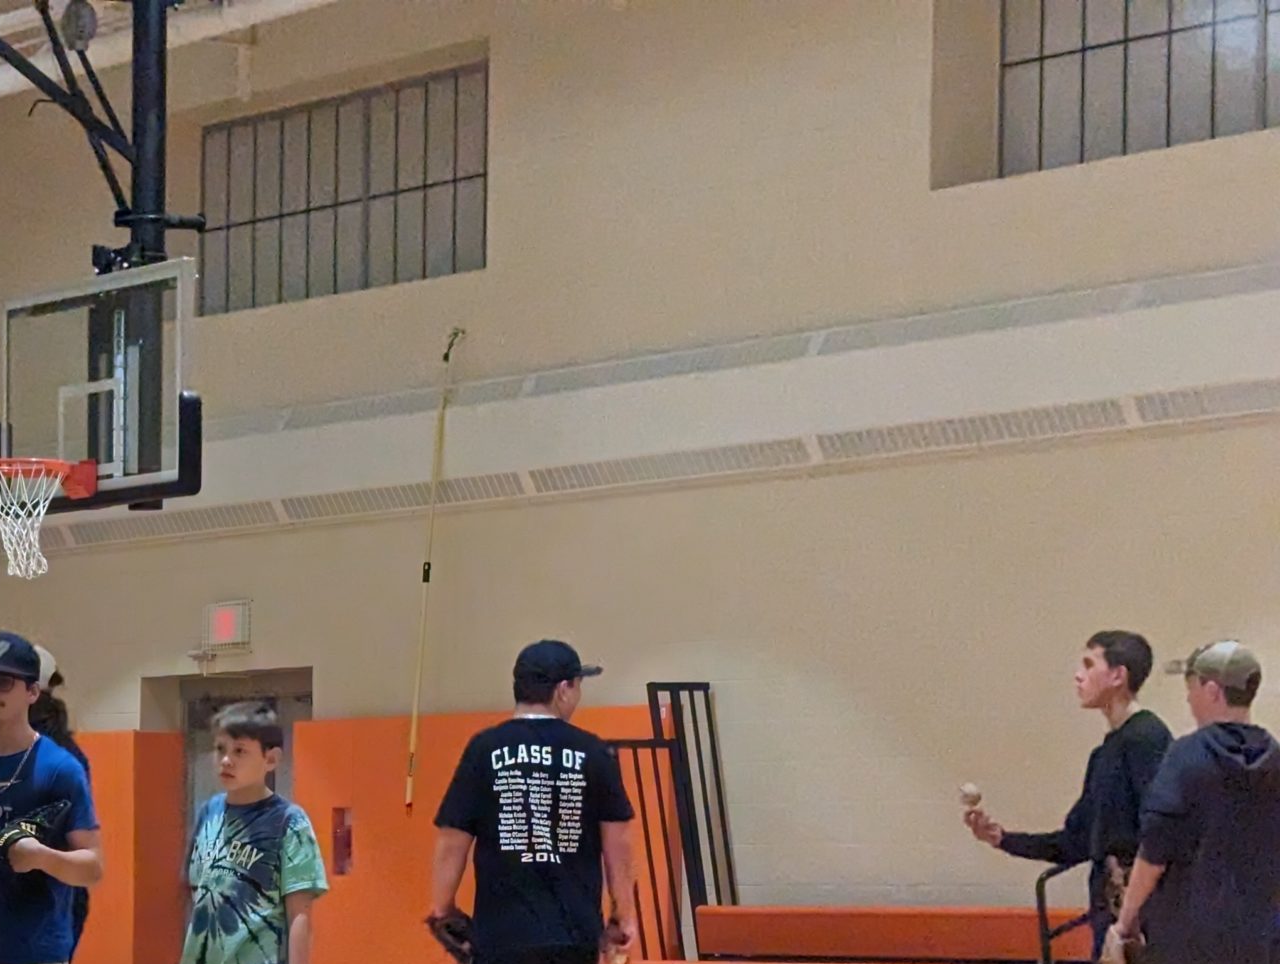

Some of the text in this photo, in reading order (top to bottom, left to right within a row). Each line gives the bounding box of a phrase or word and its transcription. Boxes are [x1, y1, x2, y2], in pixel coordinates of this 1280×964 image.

[491, 744, 586, 770] CLASS OF
[226, 840, 264, 870] BAY
[521, 853, 561, 864] 2011
